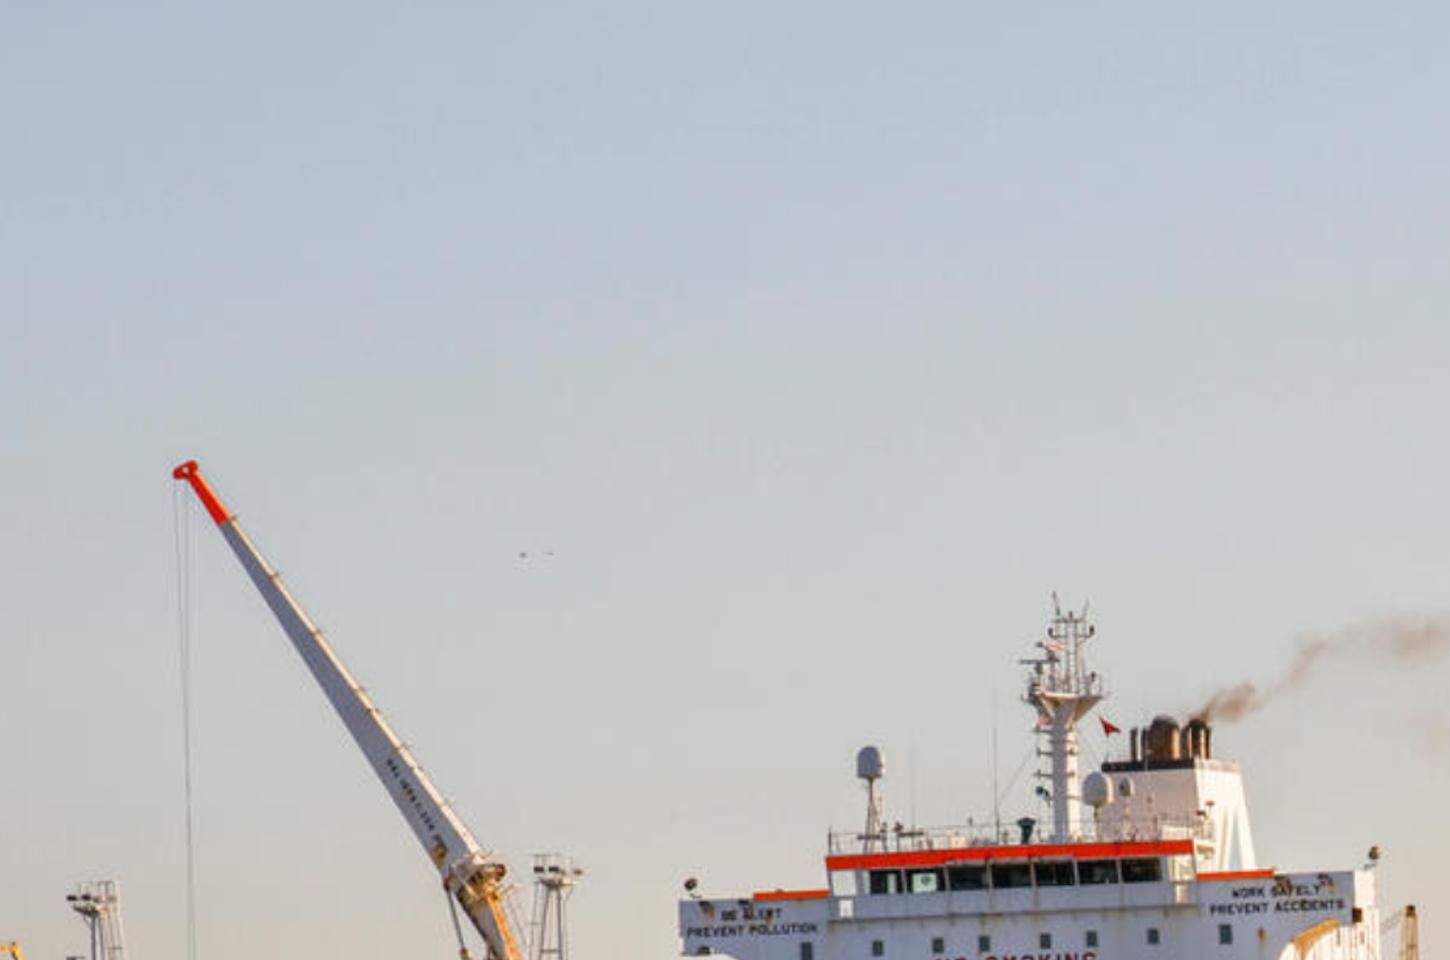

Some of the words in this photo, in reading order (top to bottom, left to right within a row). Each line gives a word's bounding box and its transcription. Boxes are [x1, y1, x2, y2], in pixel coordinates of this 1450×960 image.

[1210, 903, 1268, 915] PREVENT
[1274, 899, 1346, 912] ACCIDENTS
[686, 924, 743, 938] PREVENT
[749, 922, 818, 936] POLLUTION
